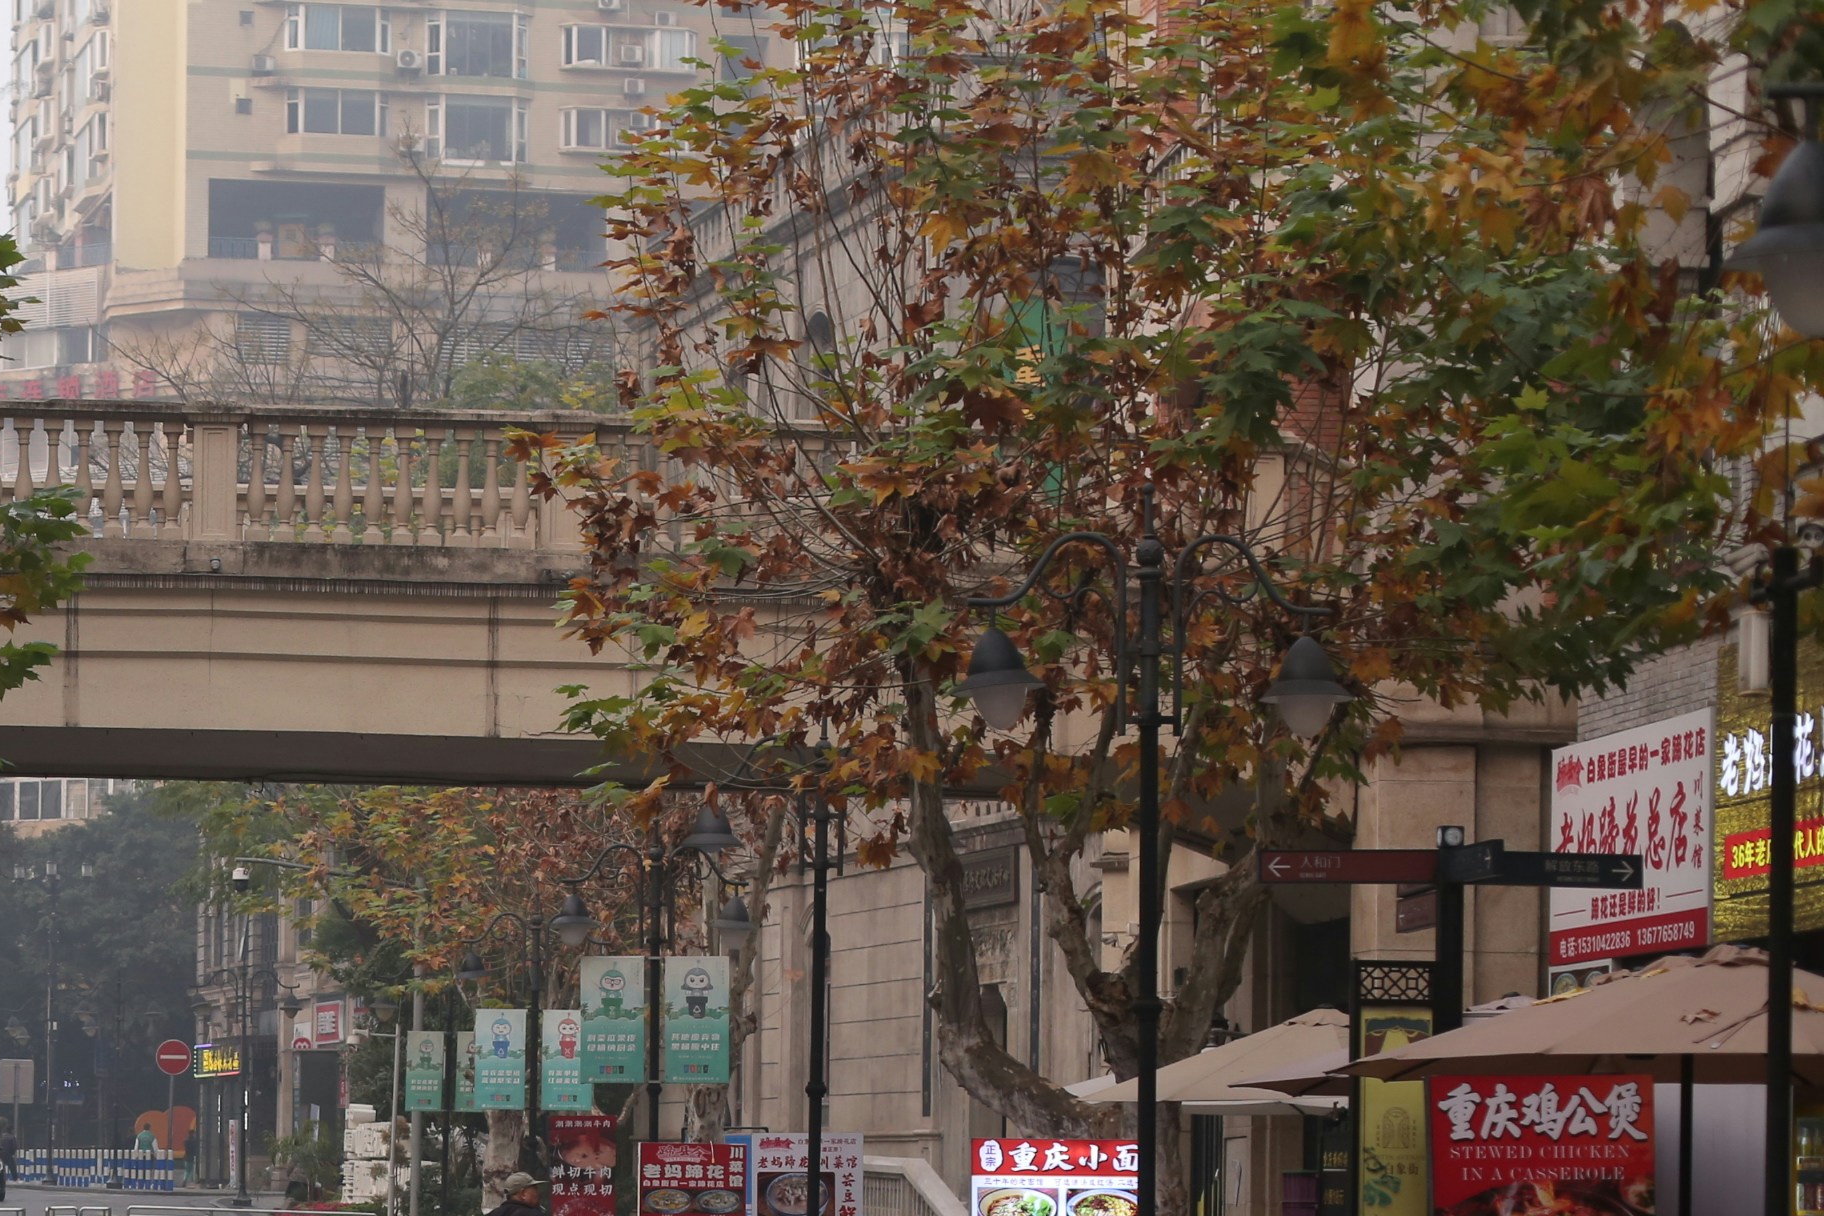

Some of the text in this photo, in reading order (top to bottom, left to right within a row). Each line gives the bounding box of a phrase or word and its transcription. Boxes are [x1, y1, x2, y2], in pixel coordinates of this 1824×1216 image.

[1587, 727, 1705, 784] 白象街最早的一家蹄花店
[1300, 856, 1341, 869] 人和门
[1545, 860, 1600, 873] 解放东路
[1636, 920, 1696, 946] 13677658749
[1437, 1082, 1649, 1141] 重庆鸡公煲
[985, 1141, 1139, 1172] 正宗 重庆小面
[1450, 1145, 1630, 1159] STEWED CHICKEN
[552, 1163, 612, 1179] 鲜切牛肉
[643, 1164, 724, 1179] 老妈蹄花
[729, 1146, 743, 1188] 川菜馆
[1462, 1166, 1625, 1180] IN A CASSEROLE
[552, 1183, 613, 1197] 现点现切
